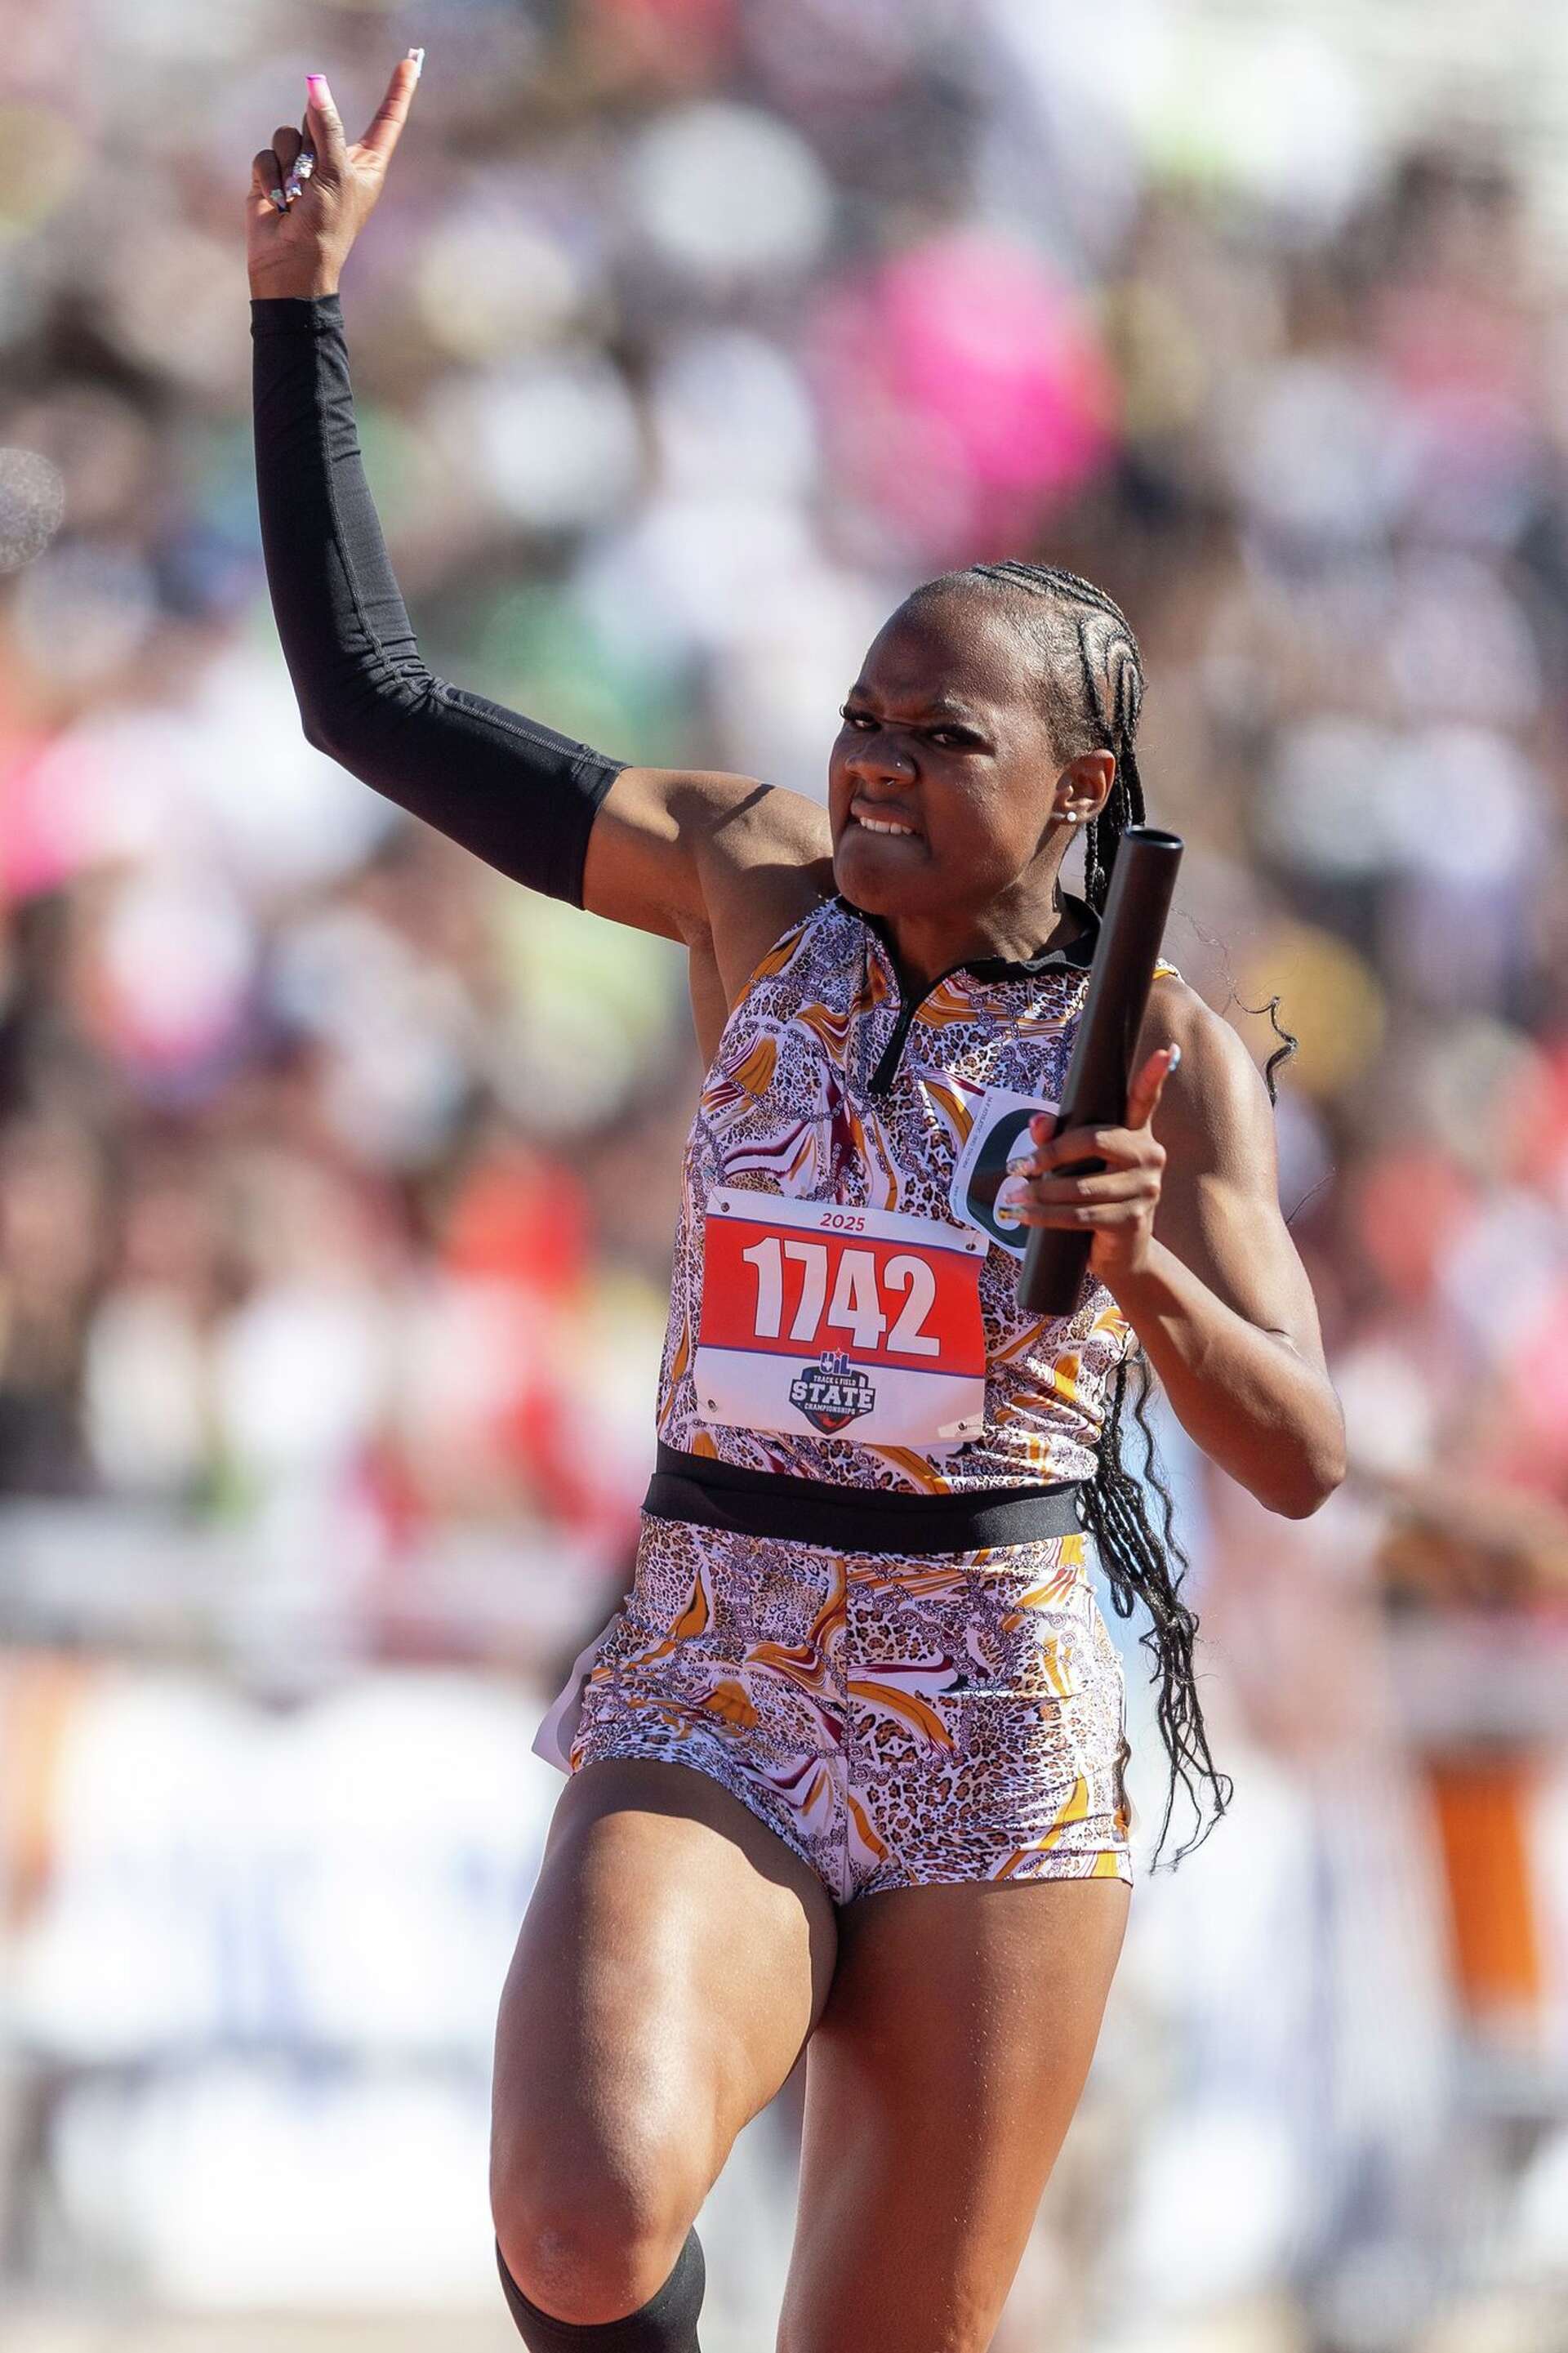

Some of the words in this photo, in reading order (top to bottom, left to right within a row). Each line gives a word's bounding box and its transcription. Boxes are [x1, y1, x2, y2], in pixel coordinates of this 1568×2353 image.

[821, 1213, 865, 1232] 2025
[742, 1237, 941, 1357] 1742
[813, 1375, 834, 1385] TRACK
[840, 1378, 857, 1387] FIELD
[791, 1381, 874, 1409] STATE
[804, 1402, 857, 1415] CHAMPIONSHIPS
